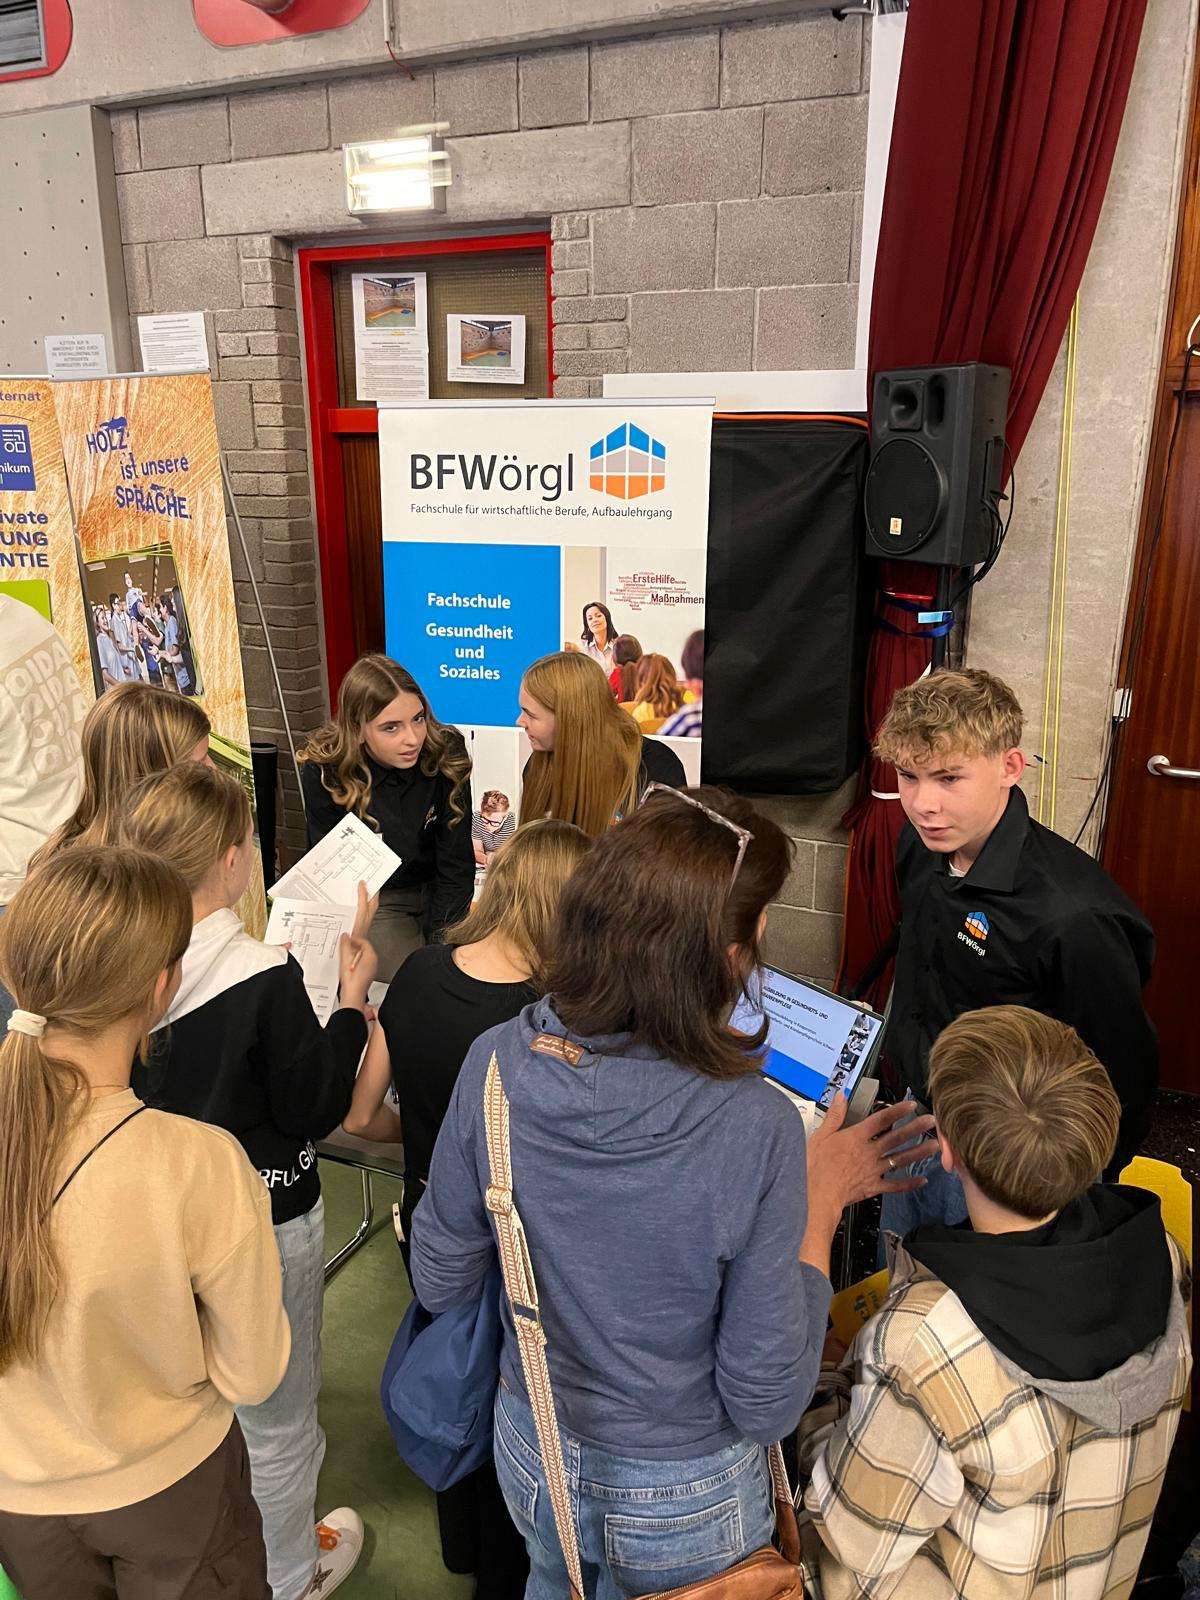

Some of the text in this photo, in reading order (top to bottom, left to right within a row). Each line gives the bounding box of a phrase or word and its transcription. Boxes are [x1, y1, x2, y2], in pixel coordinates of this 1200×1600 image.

[120, 453, 189, 480] ist unsere
[411, 453, 574, 502] BFWörgl
[411, 503, 673, 520] Fachschule für wirtschaftliche Berufe, Aufbaulehrgang
[0, 531, 48, 546] UNG
[0, 552, 49, 567] NTIE
[633, 573, 675, 584] ErsteHilfe
[427, 592, 511, 609] Fachschule
[651, 593, 704, 604] Maßnahmen
[425, 622, 514, 640] Gesundheit
[455, 645, 485, 659] und
[439, 664, 501, 680] Soziales
[957, 931, 986, 956] BFWörgl
